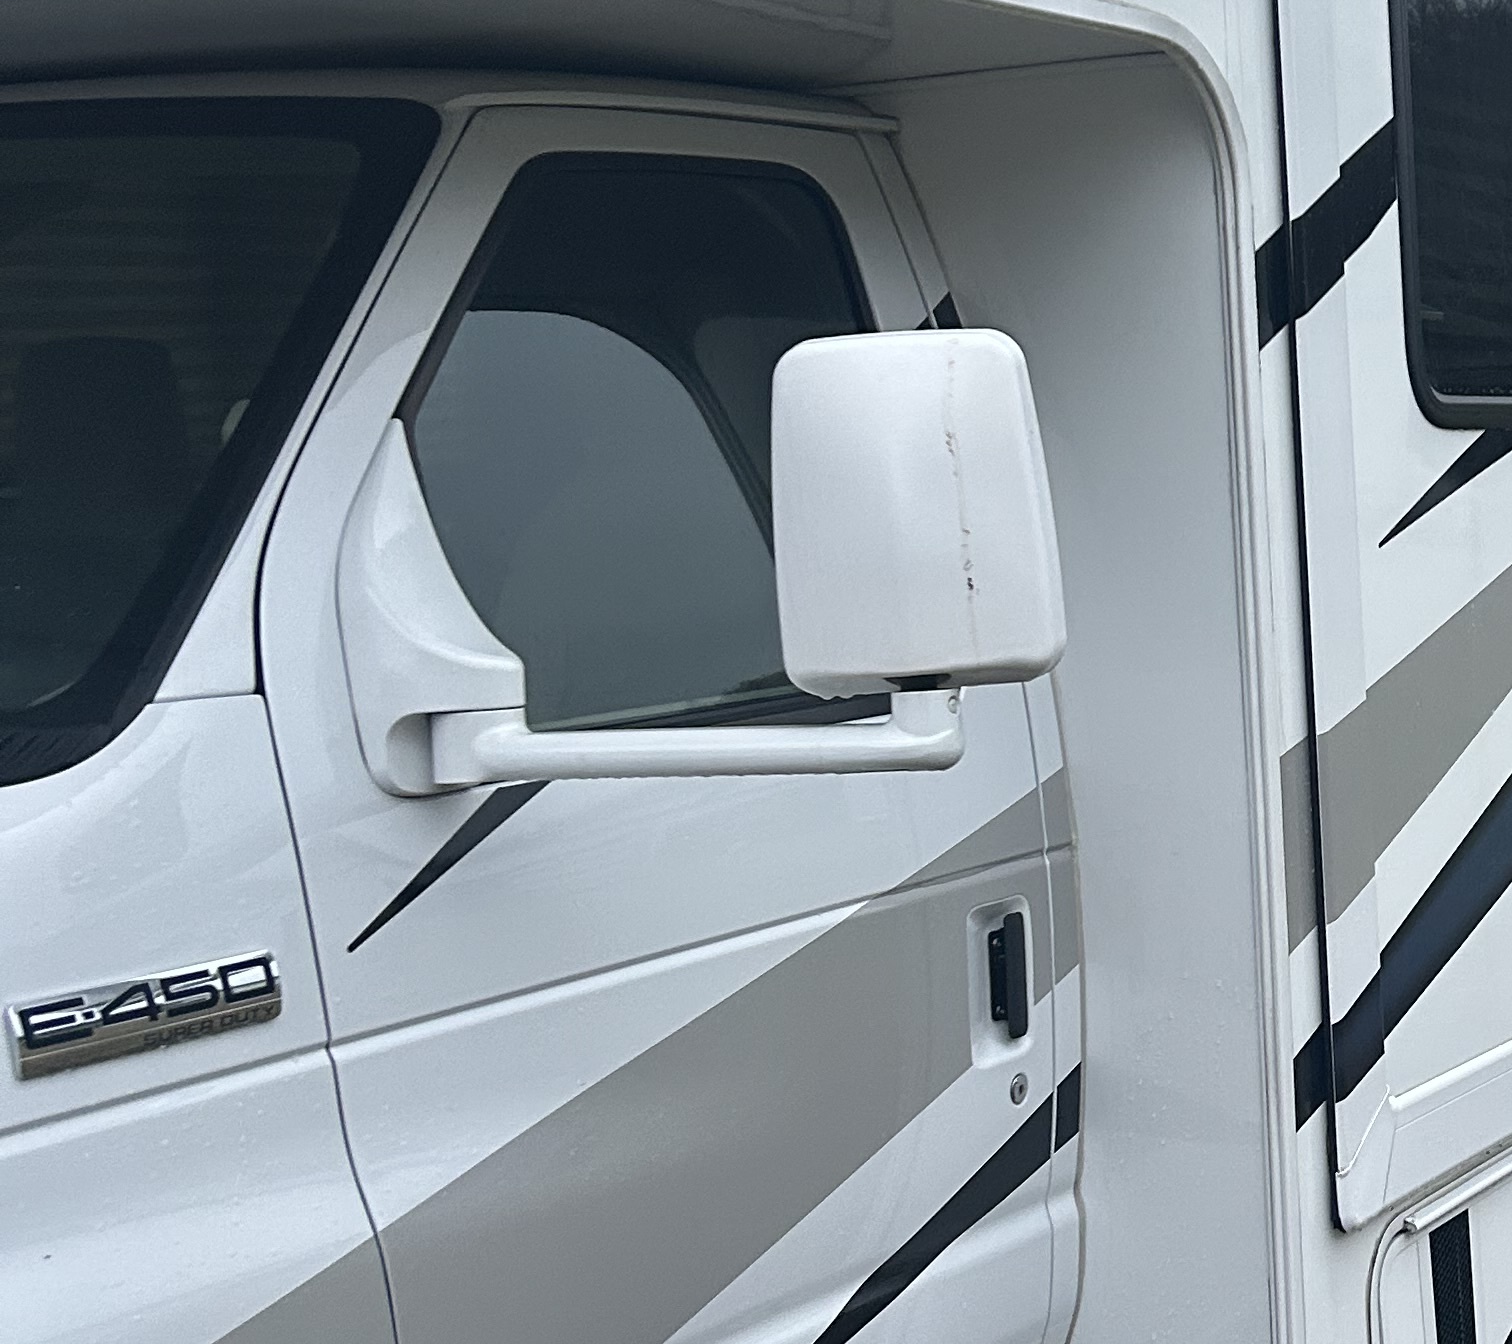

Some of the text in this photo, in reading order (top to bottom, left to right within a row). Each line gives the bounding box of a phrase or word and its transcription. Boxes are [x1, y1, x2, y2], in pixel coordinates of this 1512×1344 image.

[18, 956, 275, 1049] E-450
[143, 1004, 275, 1047] SUPER DUTY
